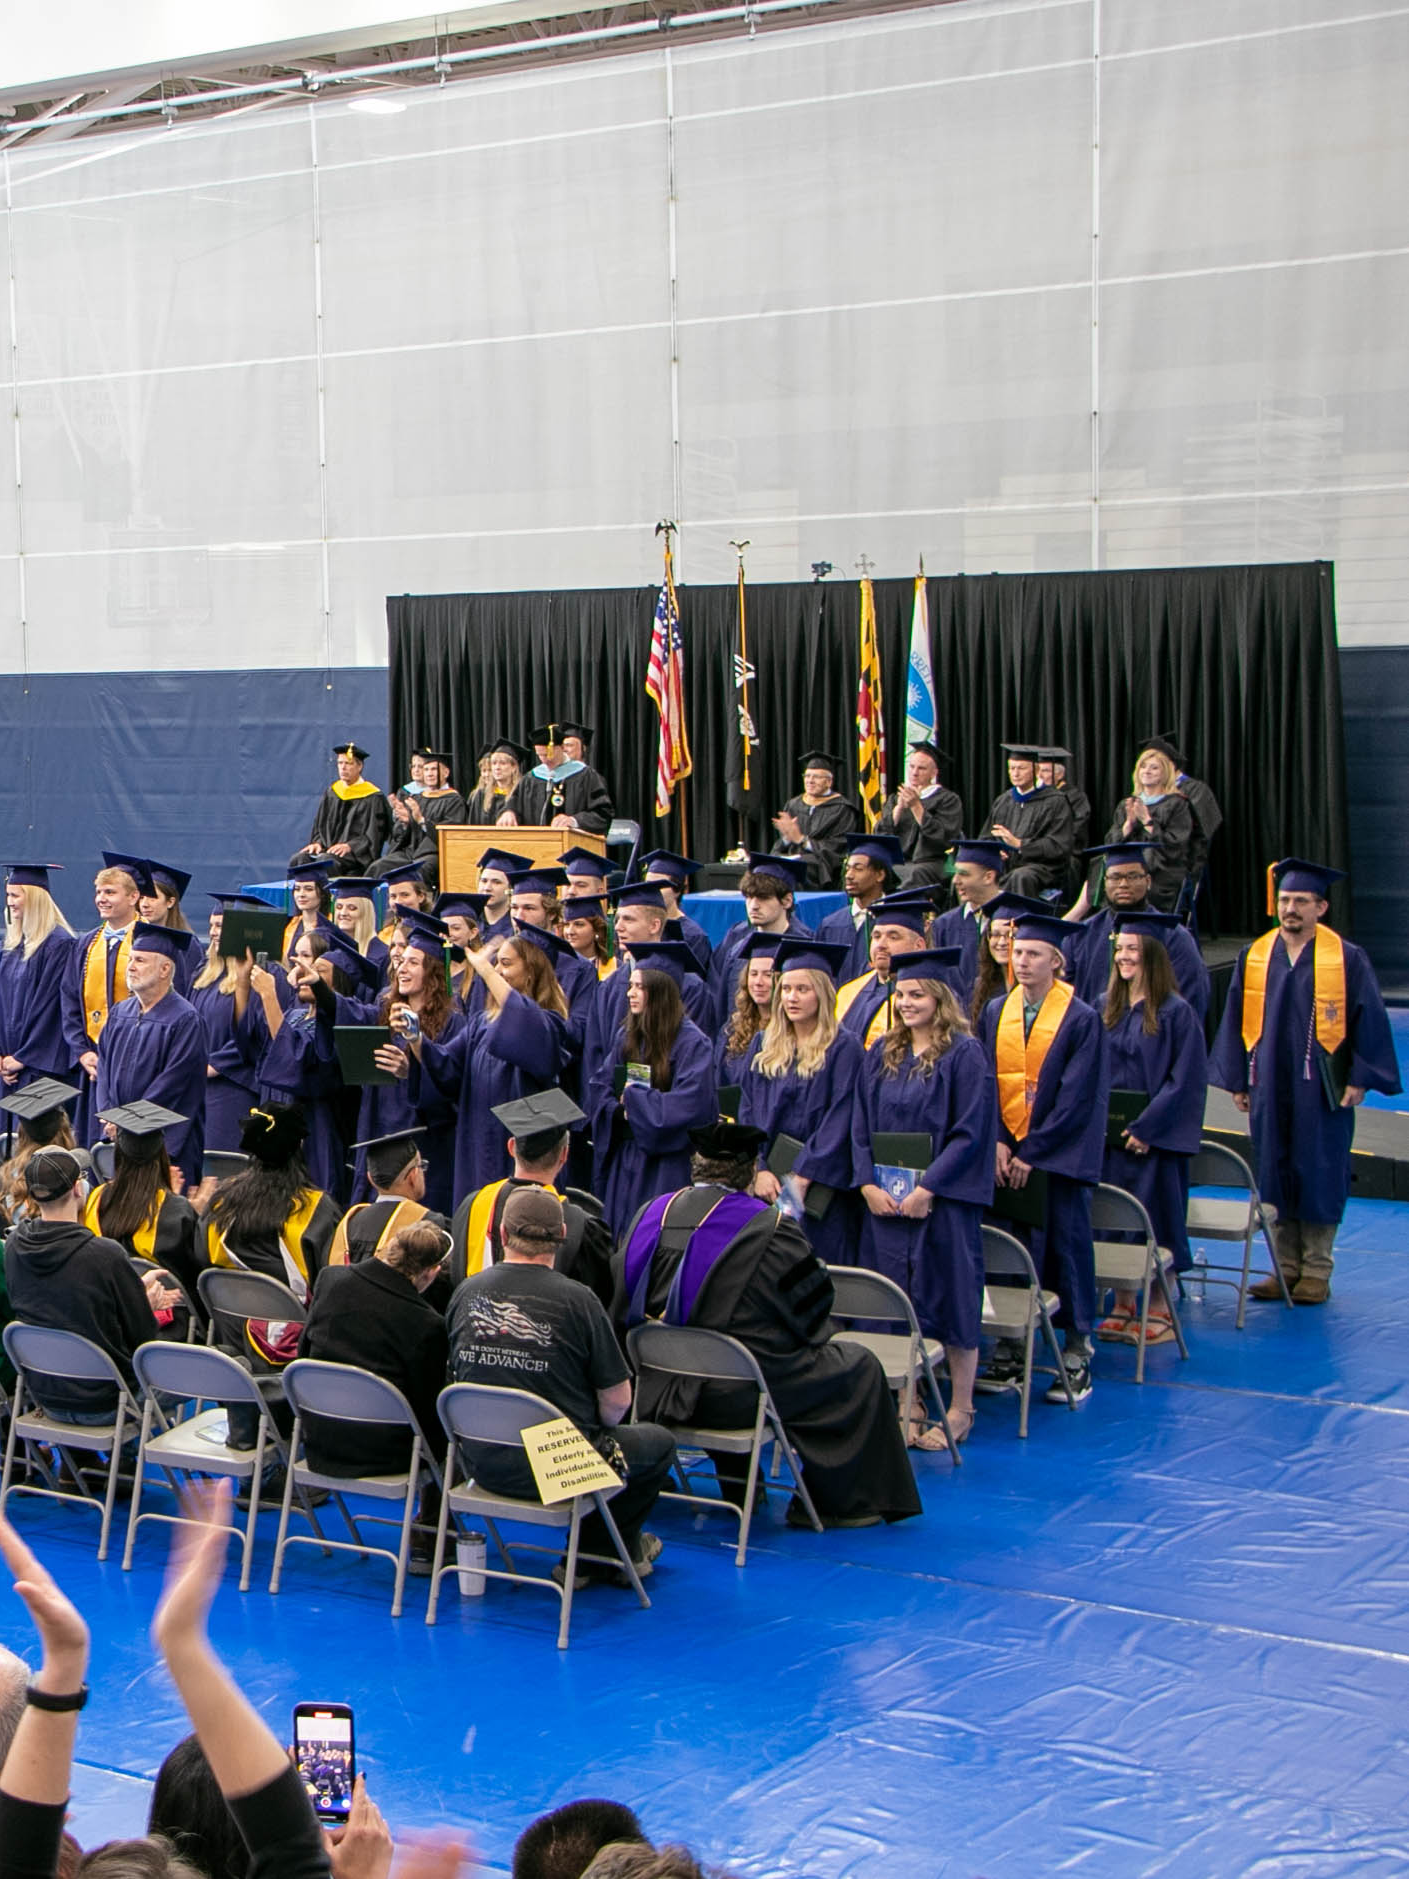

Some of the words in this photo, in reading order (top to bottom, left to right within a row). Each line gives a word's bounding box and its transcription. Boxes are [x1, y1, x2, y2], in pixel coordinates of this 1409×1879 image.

[478, 1352, 549, 1372] ADVANCE!
[546, 1428, 564, 1438] This
[552, 1450, 585, 1464] Elderly
[545, 1460, 595, 1480] Individuals
[560, 1471, 609, 1489] Disabilities
